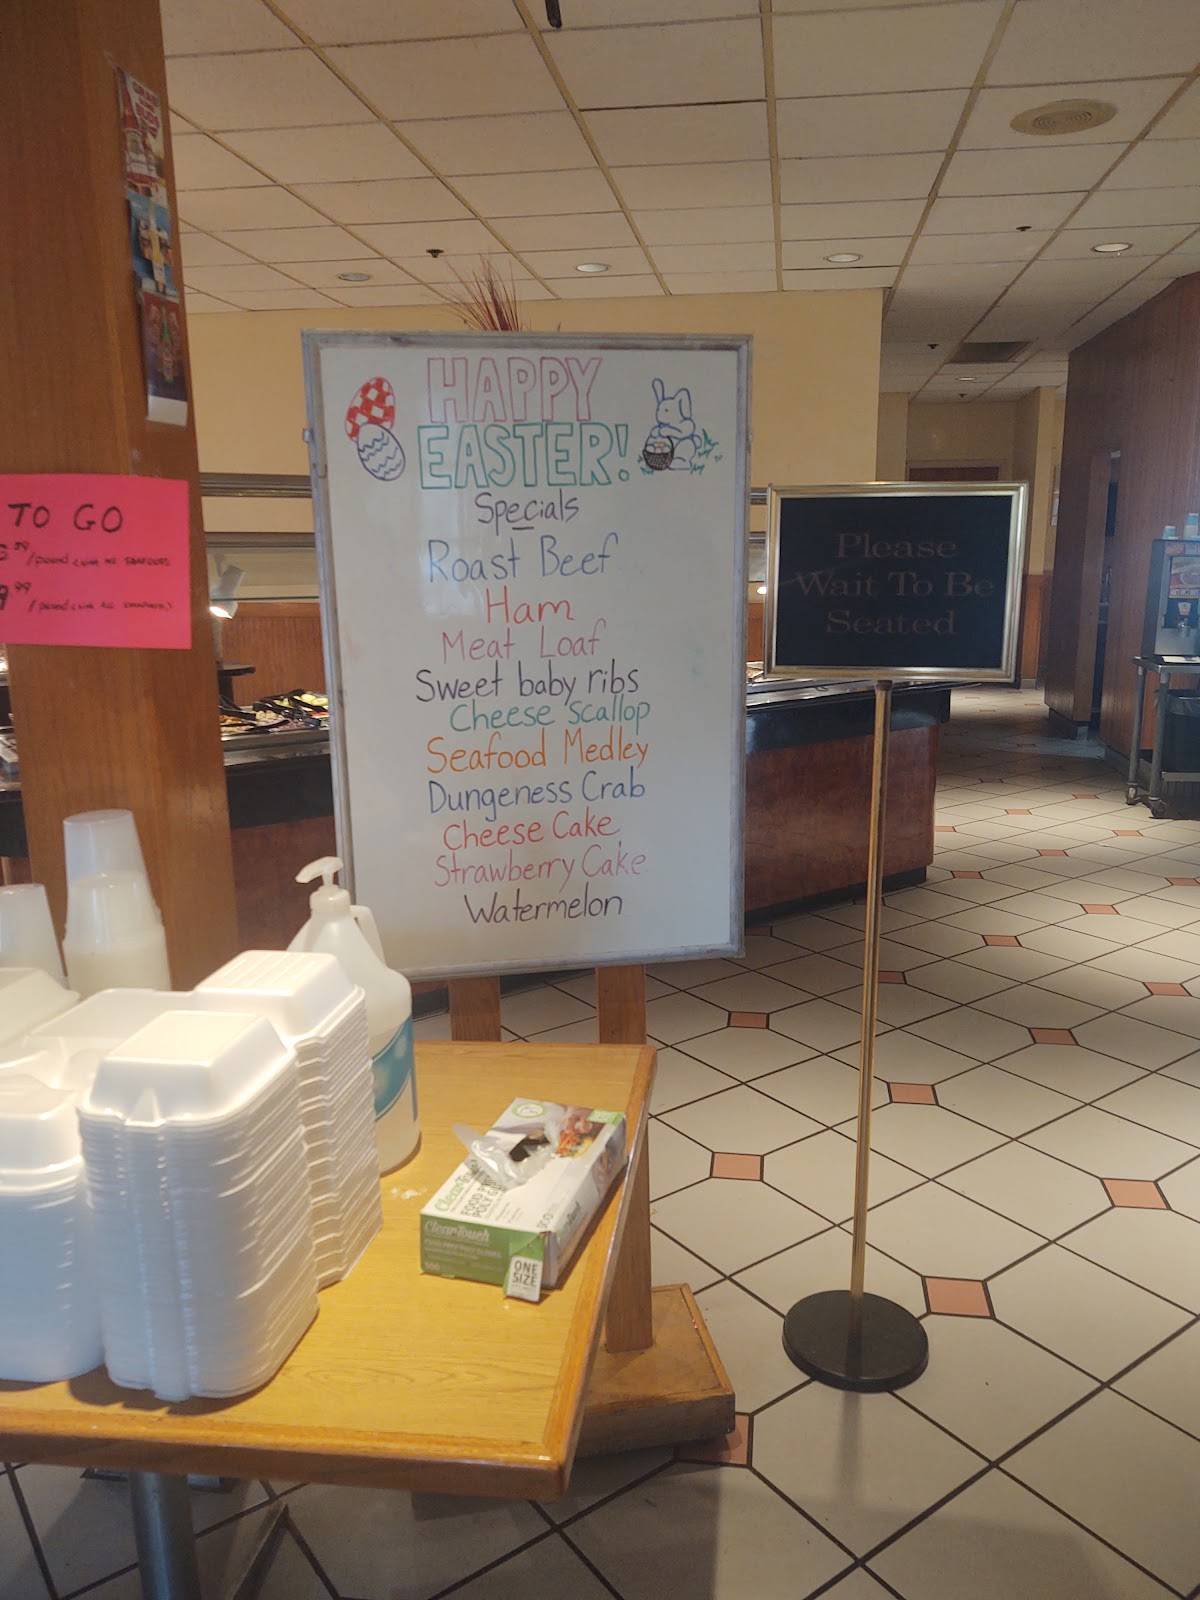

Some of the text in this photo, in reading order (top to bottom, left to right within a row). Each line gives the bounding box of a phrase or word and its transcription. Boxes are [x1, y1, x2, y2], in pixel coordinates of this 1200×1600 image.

[428, 357, 602, 423] HAPPY
[417, 423, 630, 489] EASTER!
[8, 503, 124, 533] TO GO
[474, 489, 579, 536] Specials
[429, 532, 619, 583] Roast Beef
[835, 530, 958, 559] Please
[485, 585, 574, 625] Ham
[795, 570, 994, 598] Wait To Be
[442, 617, 606, 663] Meat Loaf
[825, 609, 957, 635] Seated
[415, 659, 640, 705] Sweet baby ribs
[449, 699, 555, 732] Cheese
[427, 726, 649, 773] Seafood Medley
[429, 766, 646, 821] Dungeness Crab
[443, 806, 620, 851] Cheese Cake
[434, 840, 647, 892] Strawberry Cake
[464, 883, 624, 925] Watermelon
[511, 1272, 537, 1287] SIZE
[513, 1256, 538, 1274] ONE
